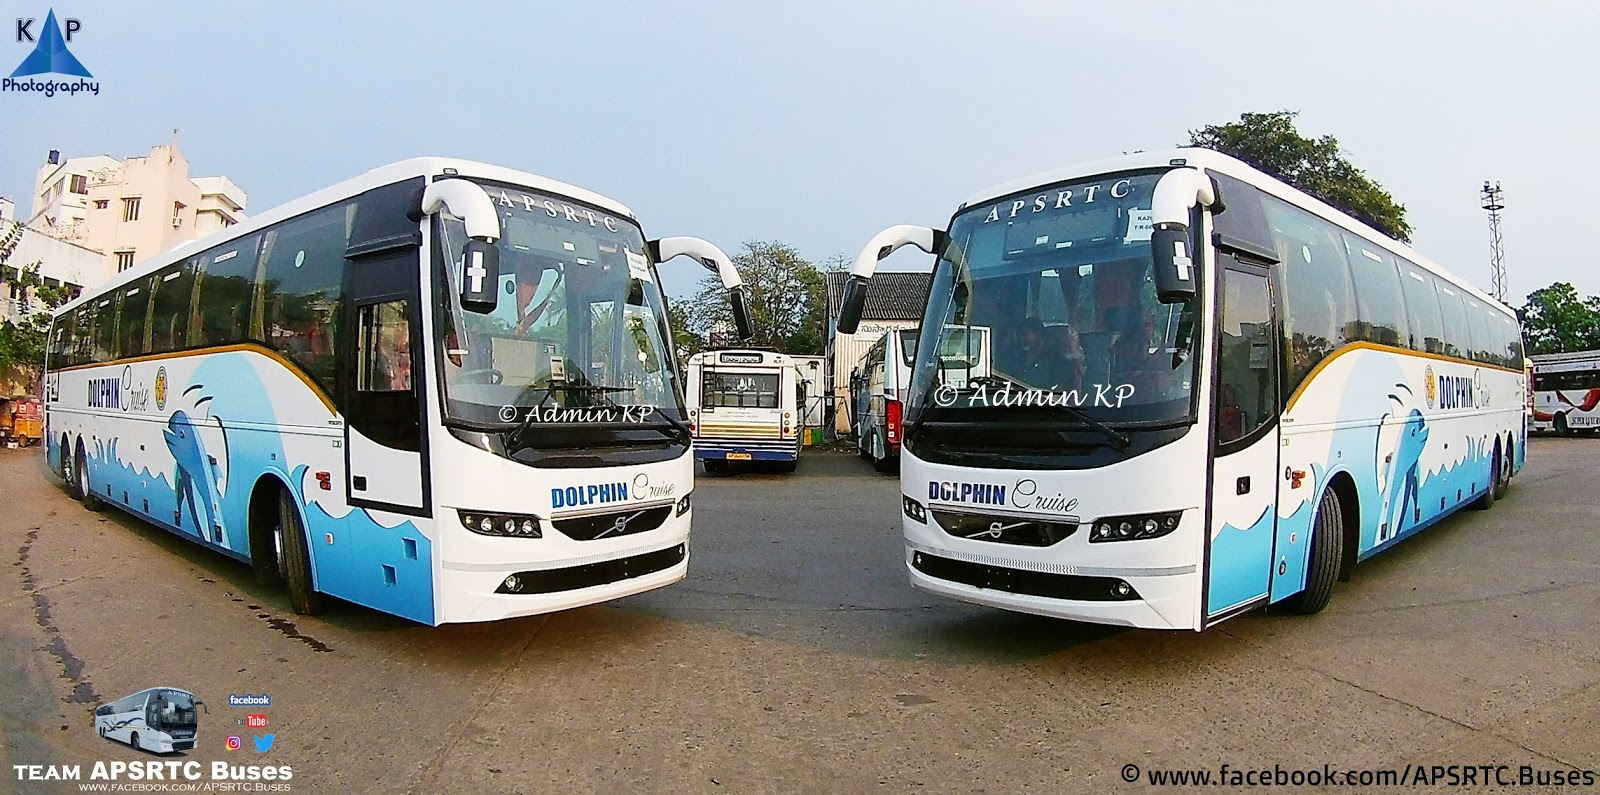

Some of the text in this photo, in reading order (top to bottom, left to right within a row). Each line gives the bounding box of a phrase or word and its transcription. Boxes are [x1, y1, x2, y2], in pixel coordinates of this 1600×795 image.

[499, 190, 618, 233] APSRTC
[984, 179, 1131, 223] APSRTC
[88, 365, 149, 411] DOLPHIN Cruise
[1439, 375, 1473, 410] DOLPHIN
[551, 473, 676, 509] DOLPHIN Cruise
[928, 478, 1079, 512] DOLPHIN Cruise
